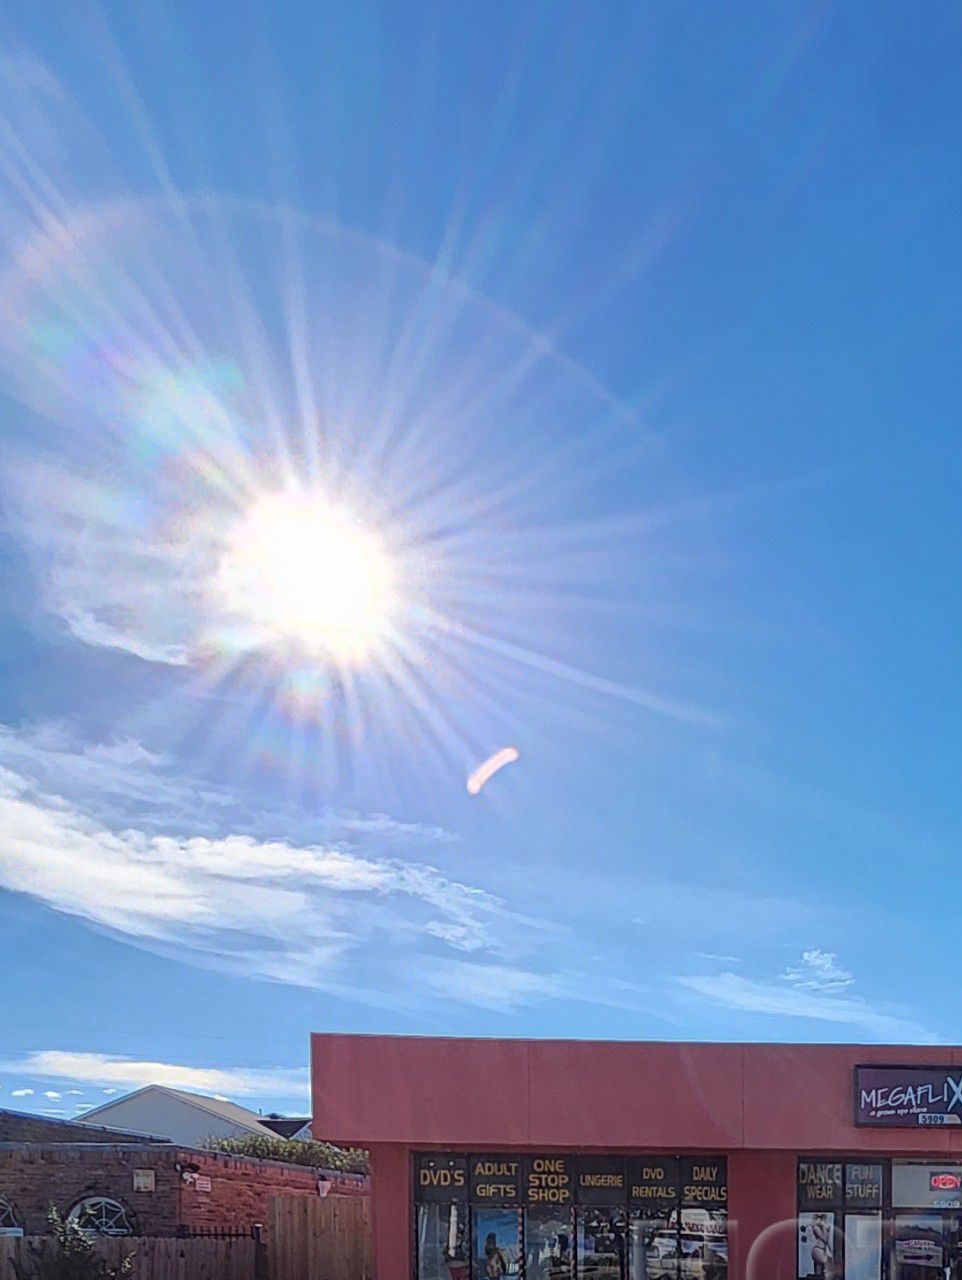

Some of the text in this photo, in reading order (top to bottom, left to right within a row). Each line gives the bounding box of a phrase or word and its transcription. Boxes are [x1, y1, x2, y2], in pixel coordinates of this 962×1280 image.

[475, 1162, 519, 1176] ADULT
[533, 1160, 565, 1172] ONE
[420, 1169, 464, 1186] DVD'S
[528, 1174, 569, 1187] STOP
[580, 1174, 623, 1187] LINGERIE
[643, 1167, 665, 1180] DVD
[693, 1166, 718, 1181] DAILY
[800, 1164, 842, 1185] DANCE
[930, 1174, 961, 1189] OPEN
[476, 1184, 516, 1197] GIFTS
[528, 1188, 570, 1202] SHOP
[632, 1186, 676, 1198] RENTALS
[683, 1185, 727, 1201] SPECIALS
[807, 1184, 833, 1199] WEAR
[846, 1184, 879, 1198] STUFF
